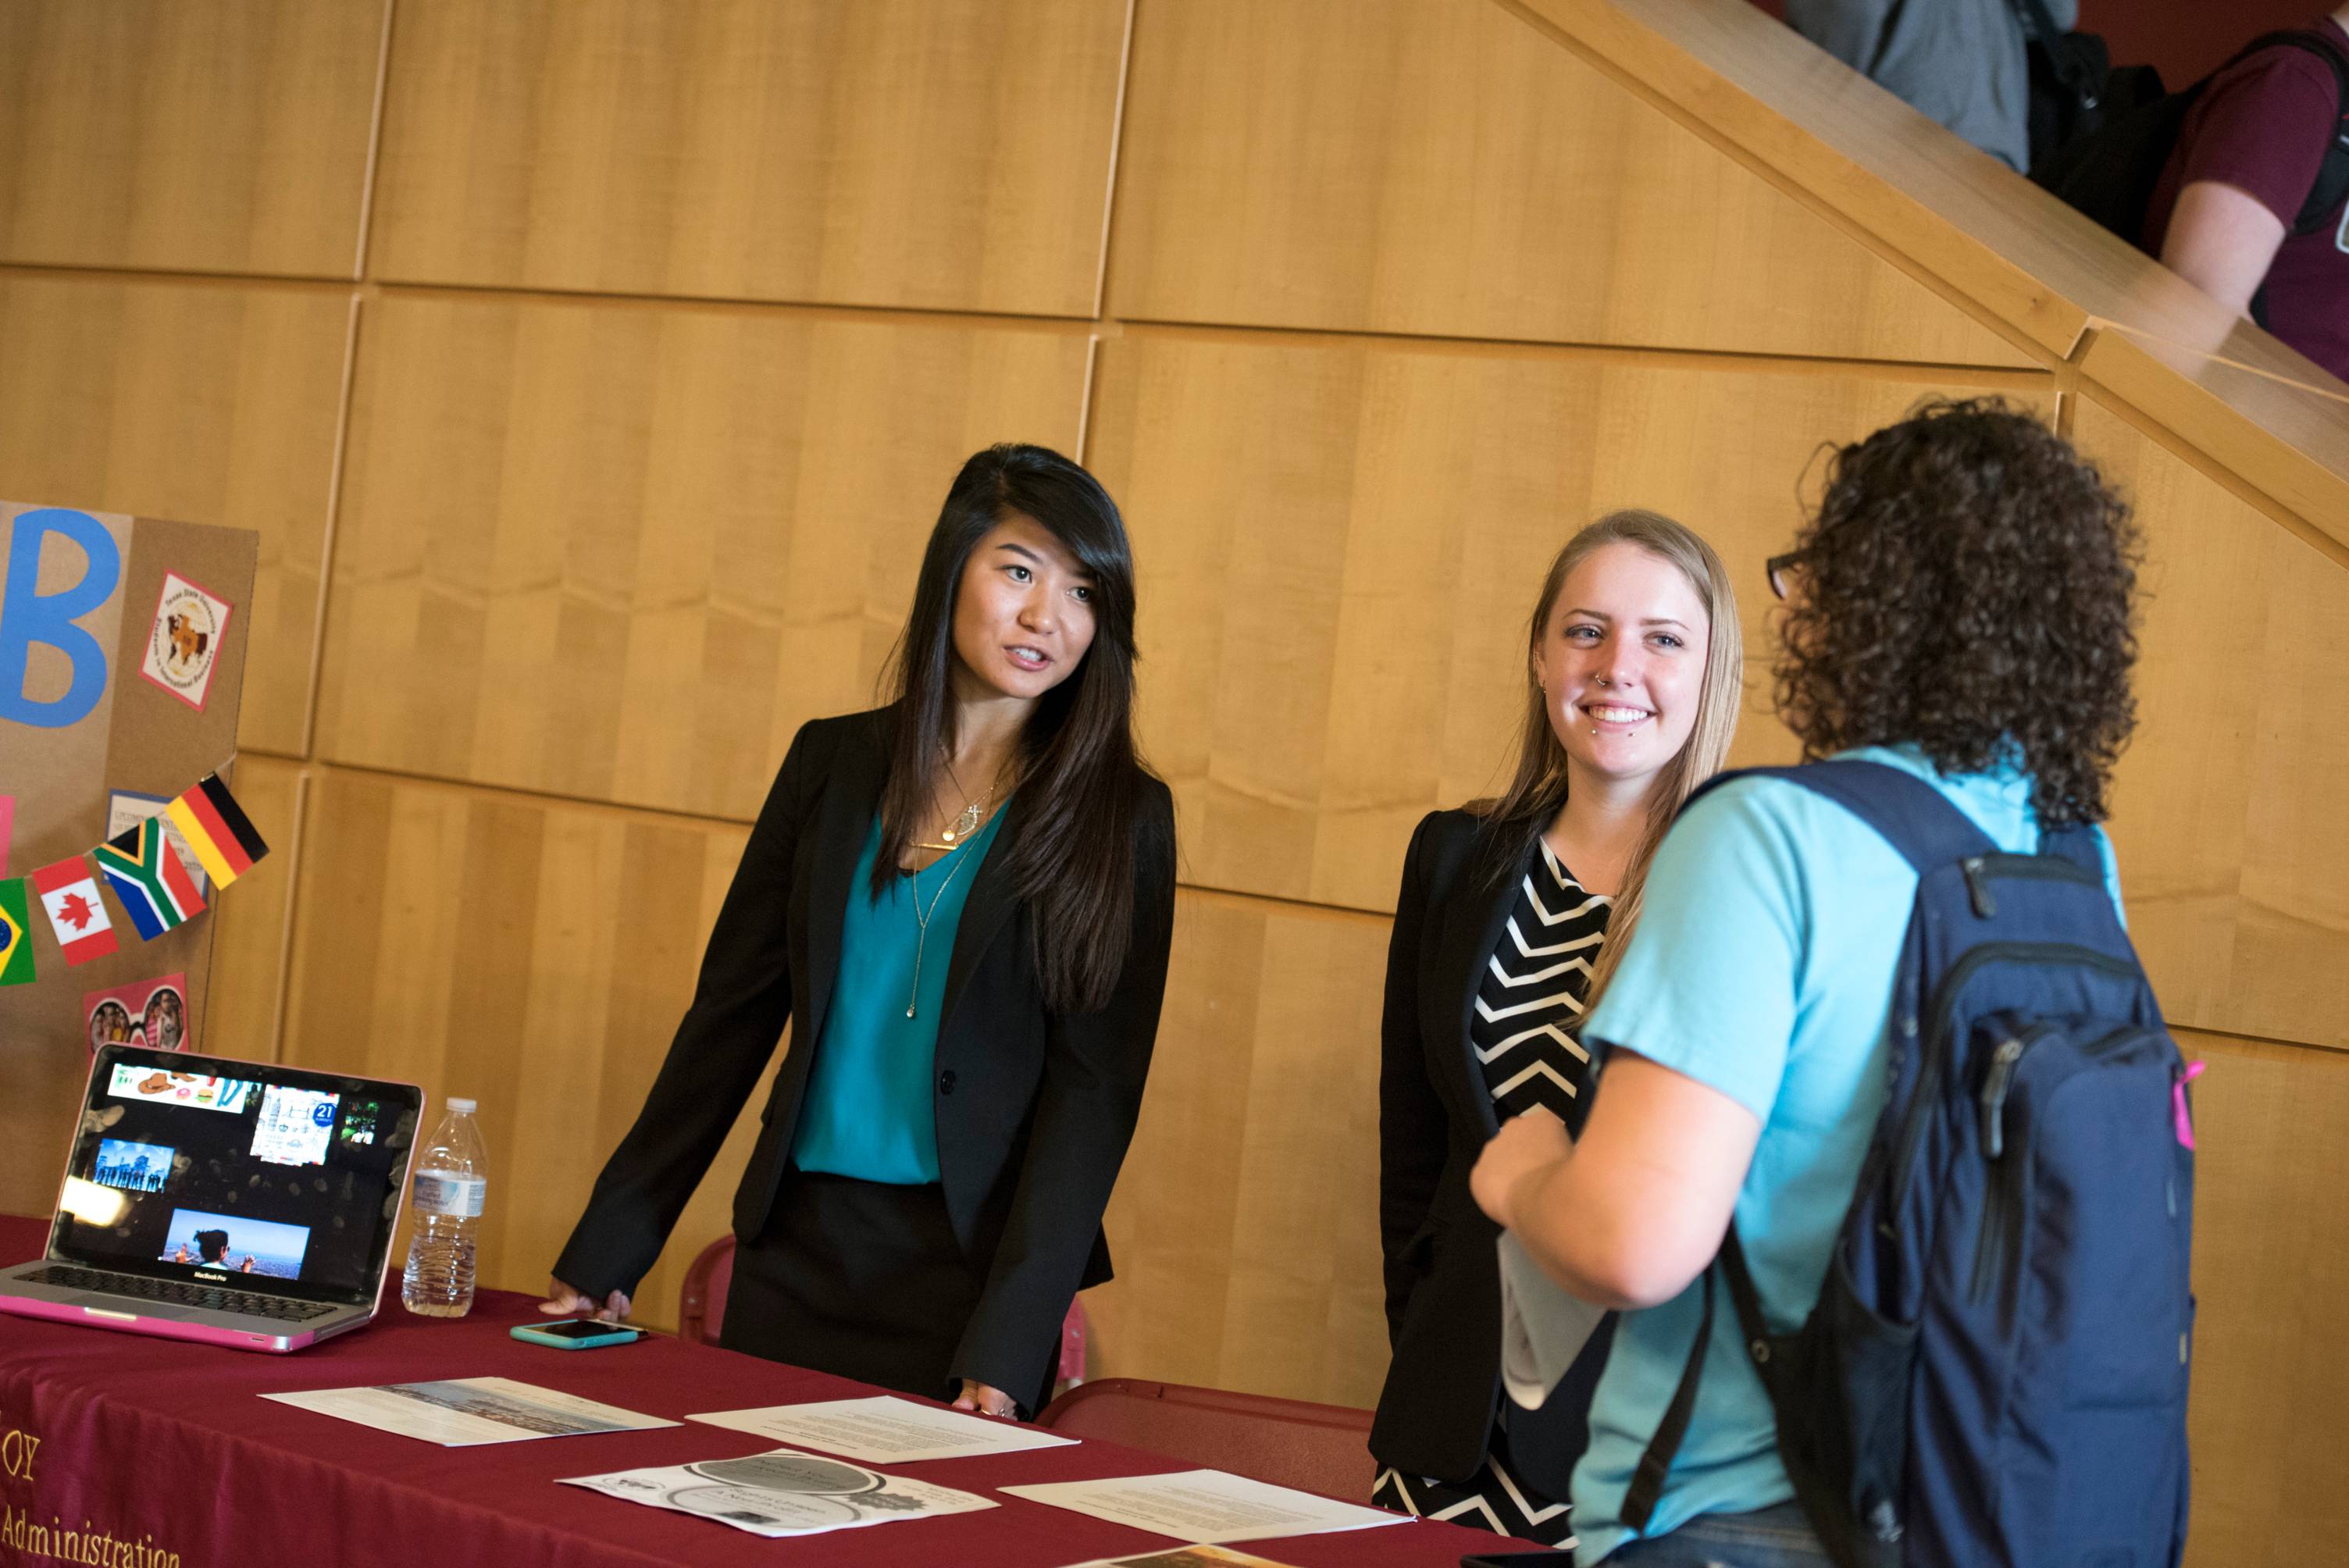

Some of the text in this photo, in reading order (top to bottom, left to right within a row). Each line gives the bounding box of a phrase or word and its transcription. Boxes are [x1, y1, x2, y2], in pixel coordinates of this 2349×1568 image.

[184, 589, 198, 598] State
[0, 508, 120, 728] B
[316, 1104, 332, 1118] 21
[194, 1271, 217, 1281] MacBook
[1, 1504, 180, 1568] Administration
